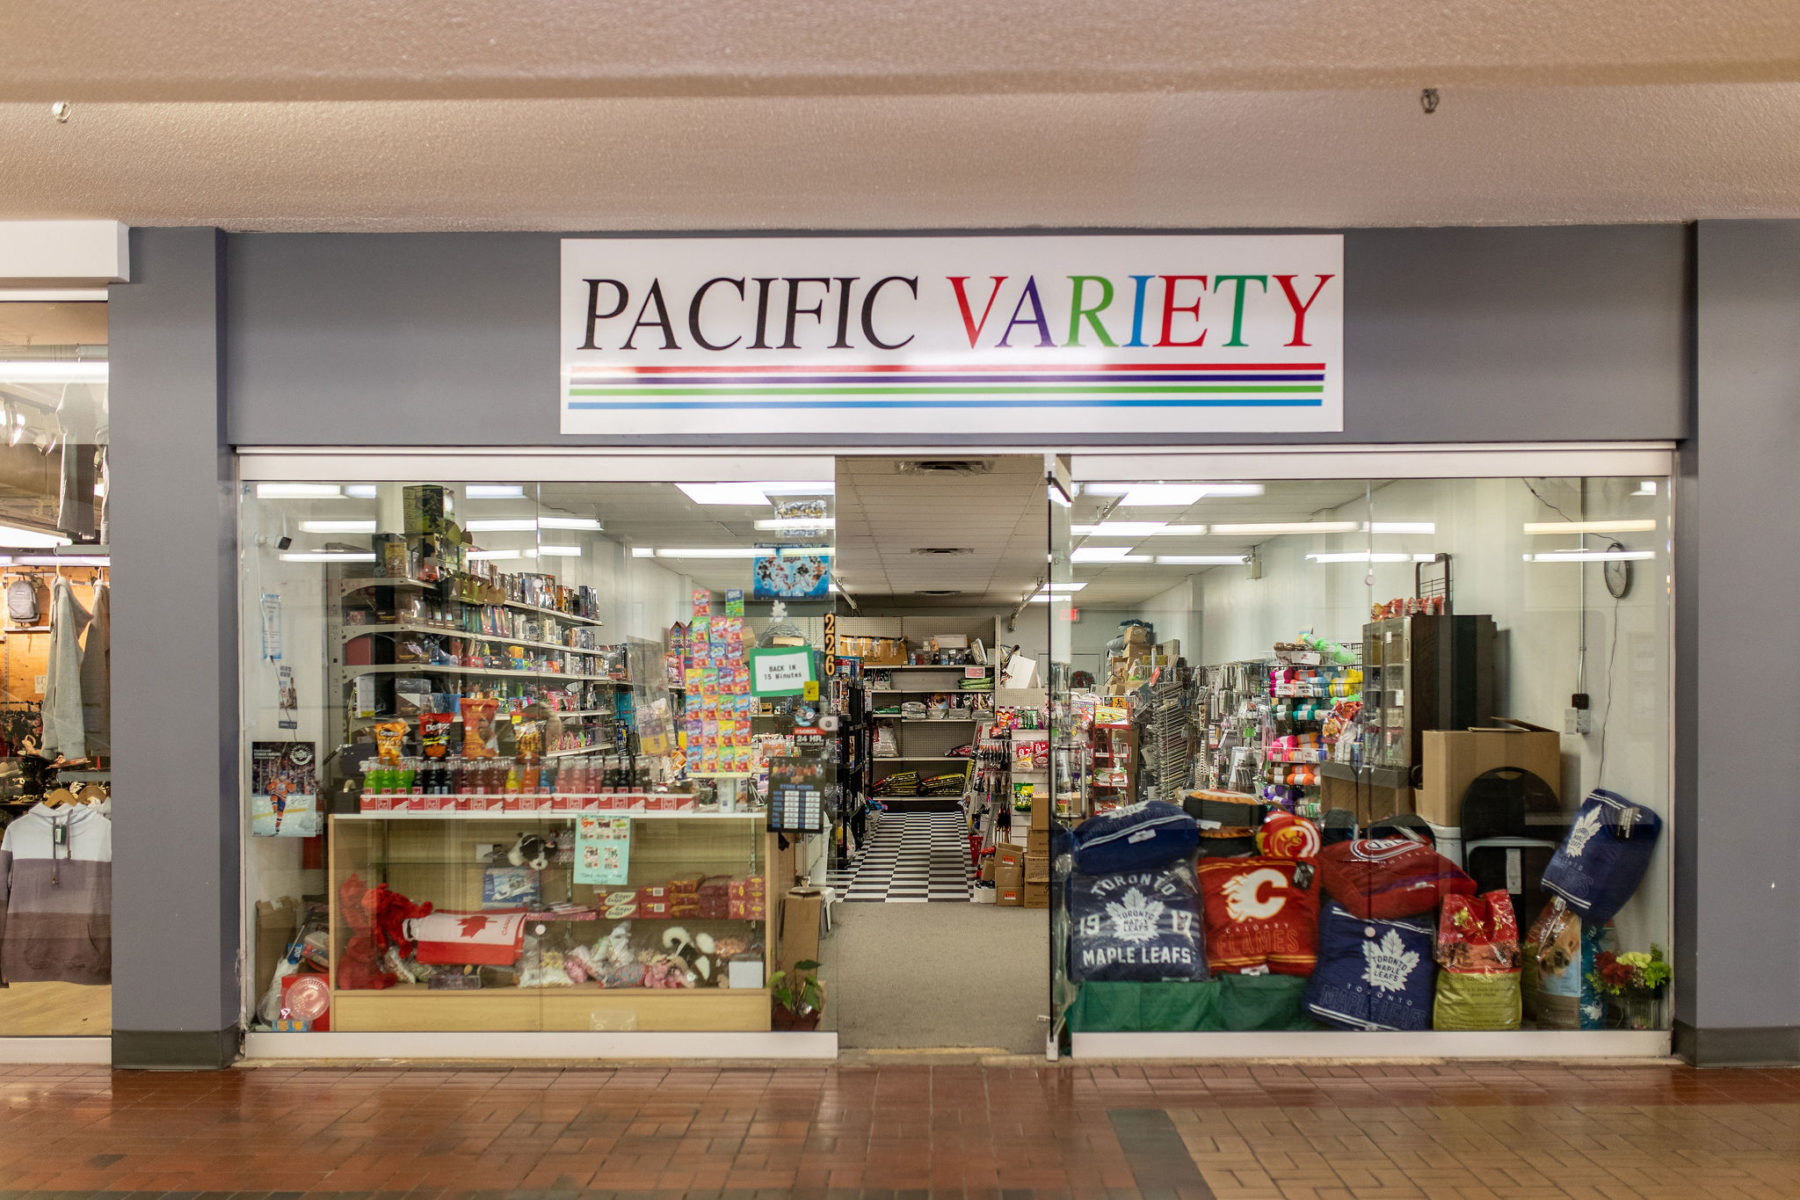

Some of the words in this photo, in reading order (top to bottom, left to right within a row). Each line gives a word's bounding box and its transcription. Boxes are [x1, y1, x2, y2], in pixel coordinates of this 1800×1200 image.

[576, 276, 918, 351] PACIFIC
[946, 274, 1336, 350] VARIETY
[824, 613, 836, 676] 226
[1091, 873, 1176, 896] TORONTO
[1080, 914, 1099, 936] 19
[1171, 910, 1192, 932] 17
[1120, 910, 1155, 920] TORONTO
[1225, 923, 1288, 934] CALGARY
[1083, 946, 1135, 966] MAPLE
[1142, 946, 1191, 964] LEAFS
[1373, 956, 1407, 971] TORONTO
[1374, 971, 1399, 981] LEAFS
[1376, 964, 1400, 974] MAPLE
